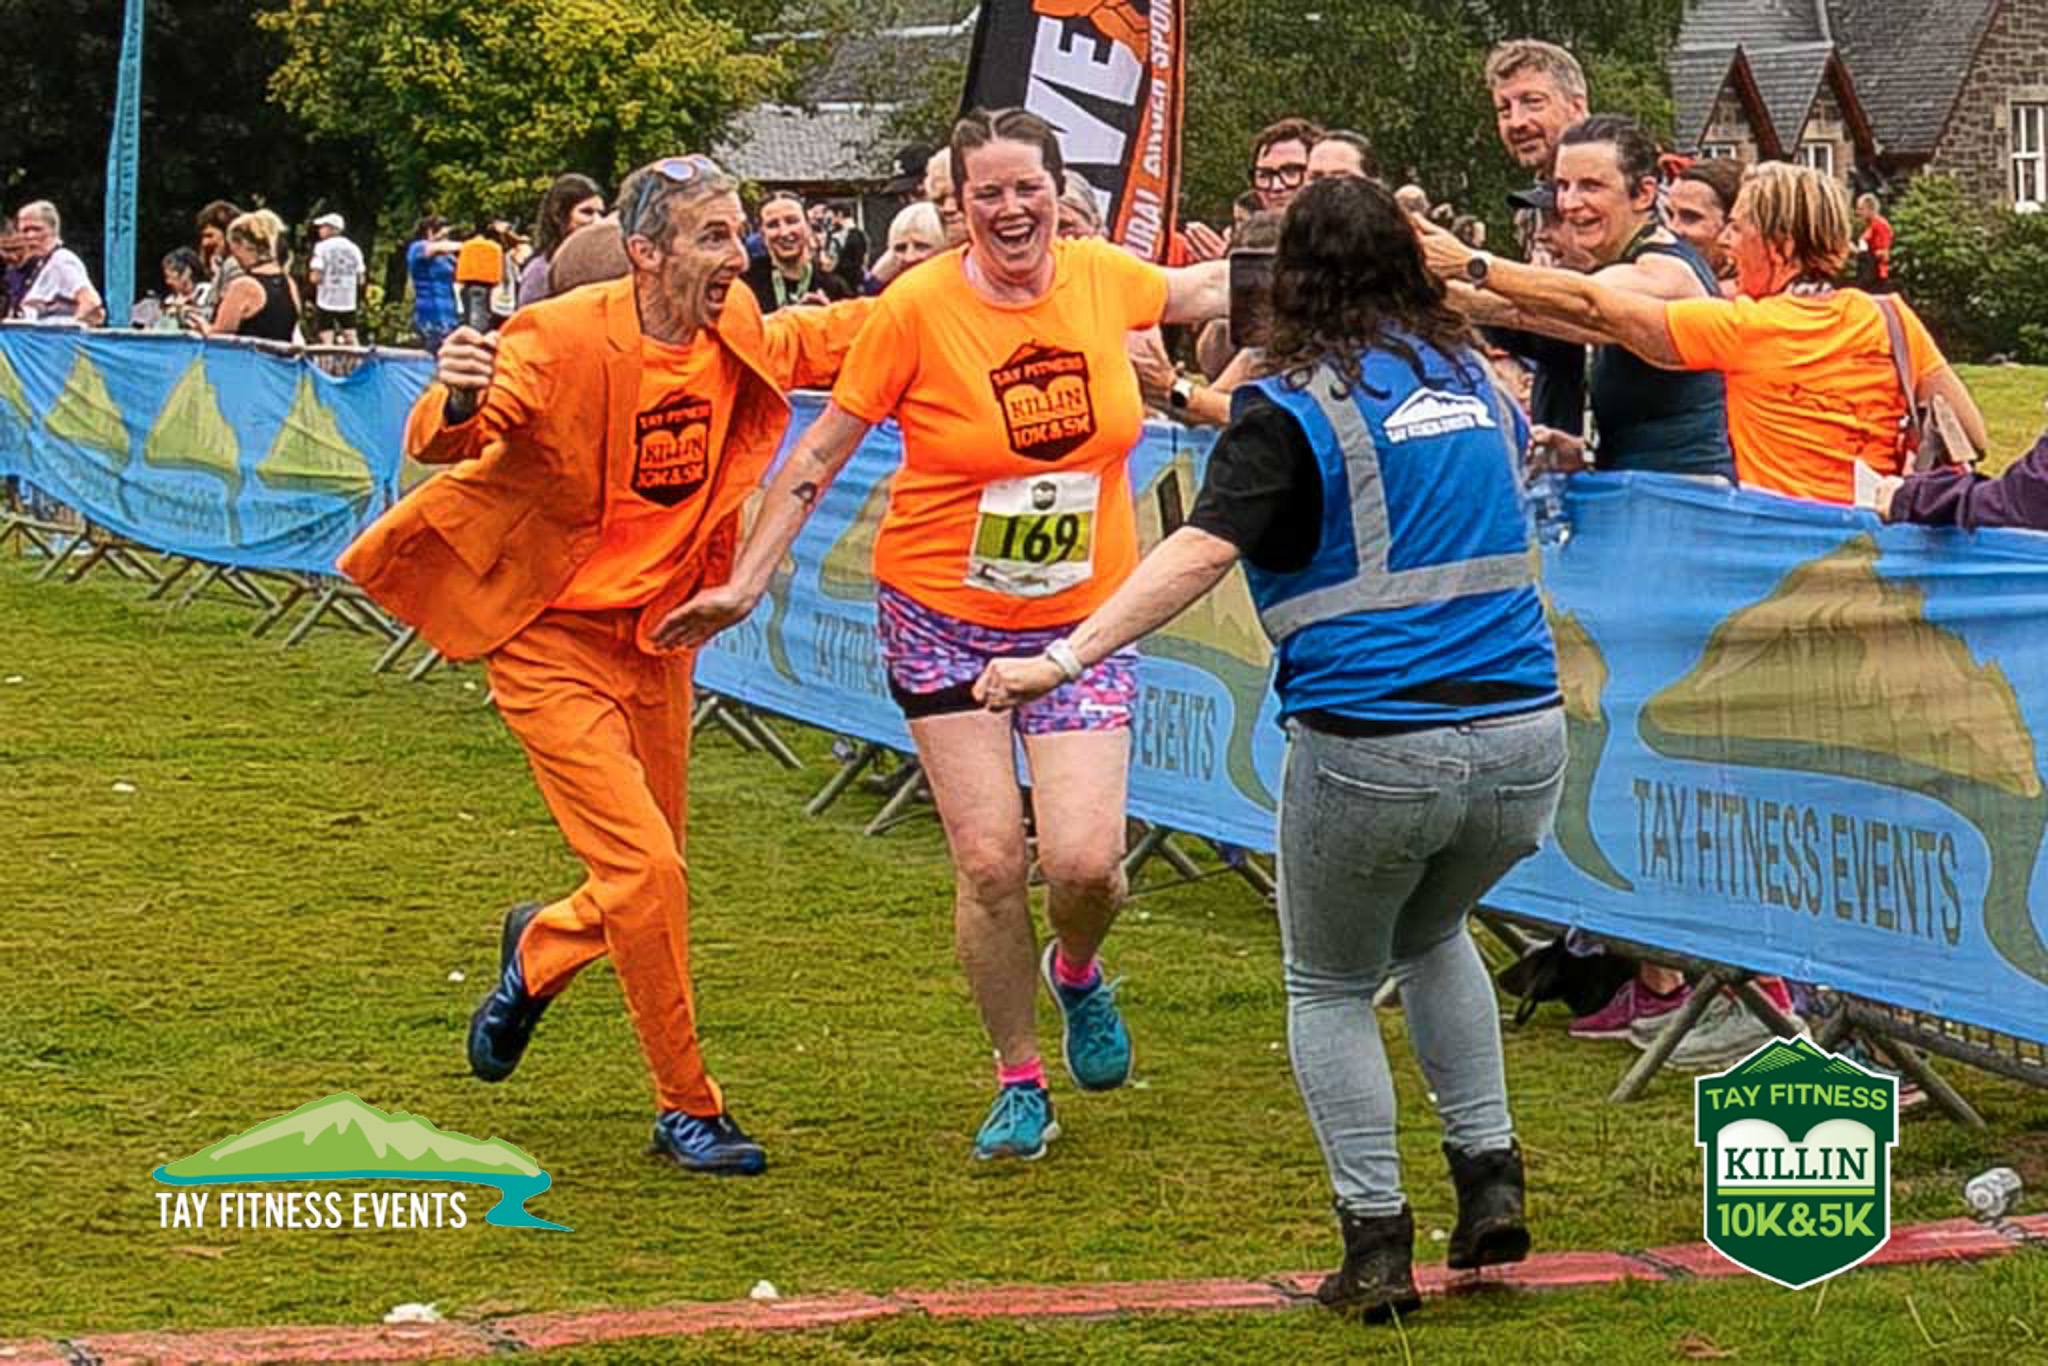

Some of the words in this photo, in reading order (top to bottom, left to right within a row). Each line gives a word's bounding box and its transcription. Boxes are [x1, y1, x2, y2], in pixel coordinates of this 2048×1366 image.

[1010, 386, 1082, 420] KILLIN
[1012, 414, 1091, 450] 10K&5K
[1000, 512, 1080, 565] 169
[1141, 683, 1217, 783] EVENTS
[1633, 778, 1687, 884] TAY
[1696, 787, 1823, 917] FITNESS
[1831, 813, 1962, 946] EVENTS
